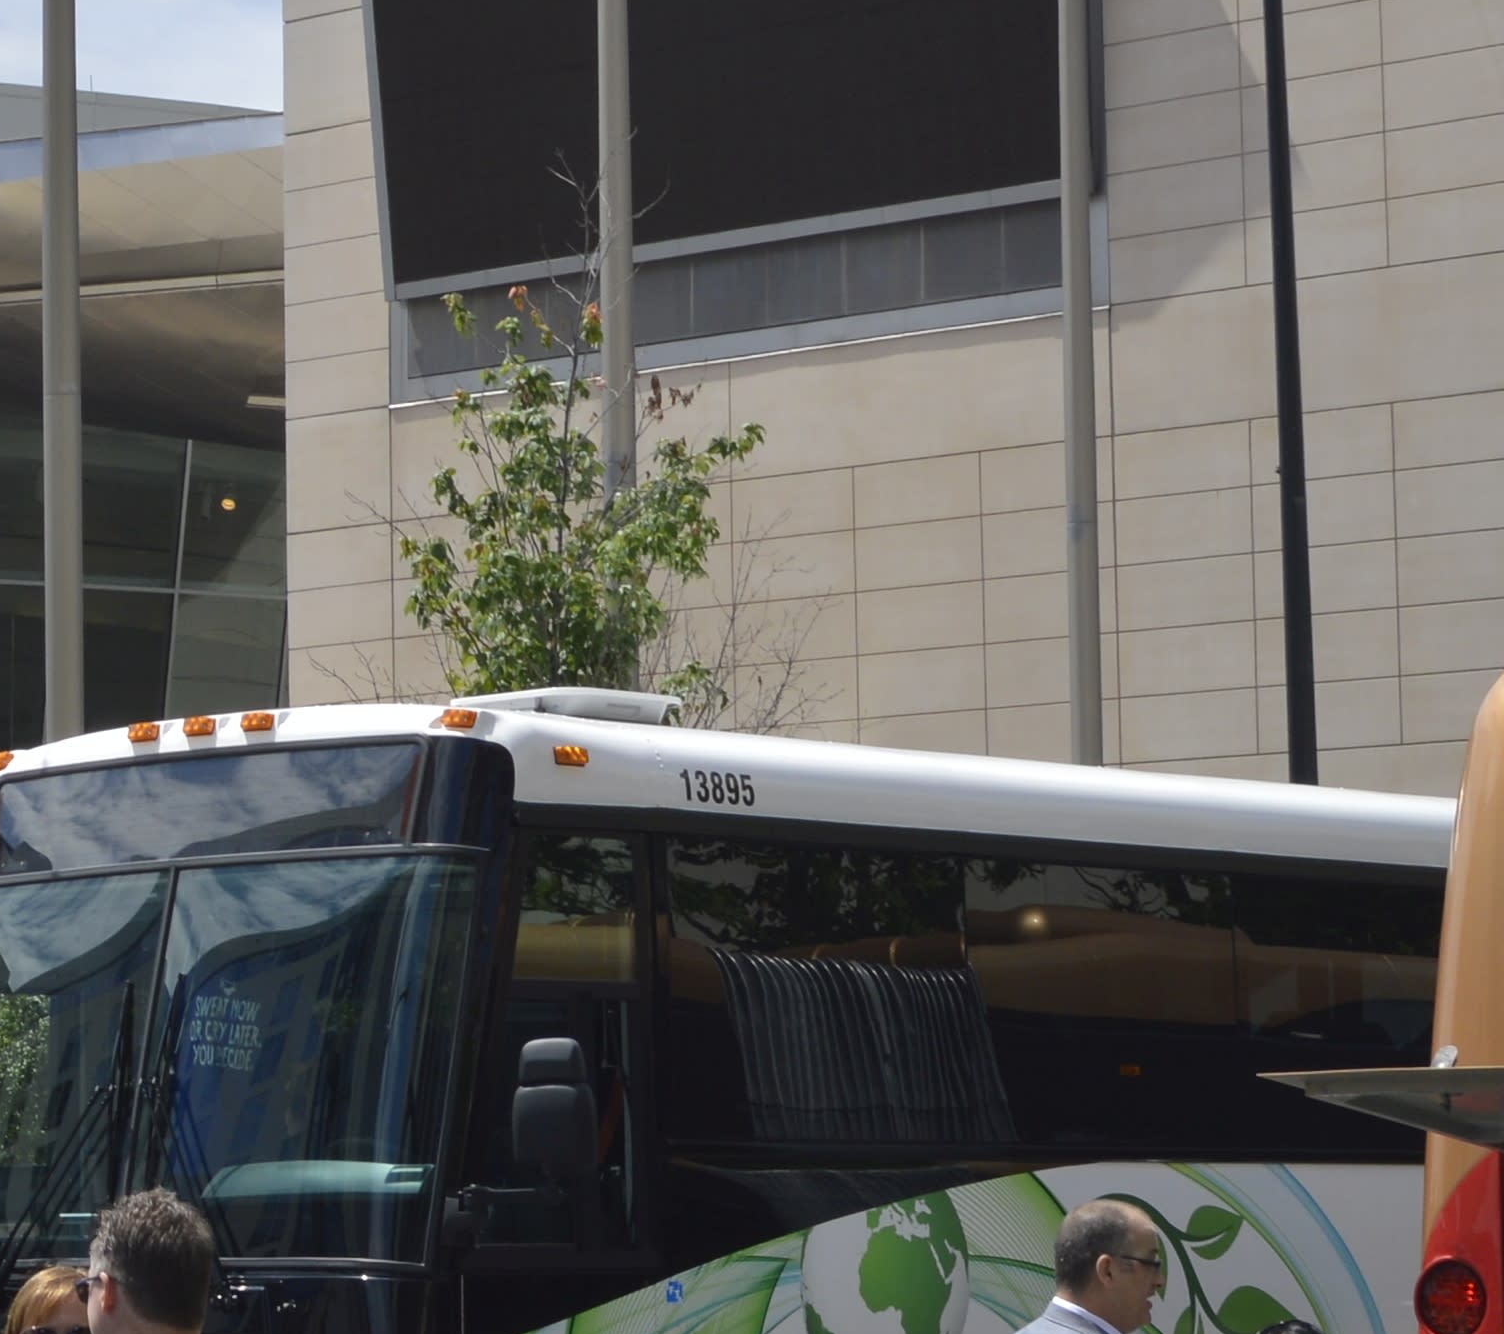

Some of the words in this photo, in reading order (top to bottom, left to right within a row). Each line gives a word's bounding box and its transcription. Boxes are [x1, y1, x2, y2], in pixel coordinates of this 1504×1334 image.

[679, 768, 756, 807] 13895
[195, 995, 230, 1018] SWEAT
[230, 997, 262, 1022] NOW
[192, 1044, 214, 1067] YOU
